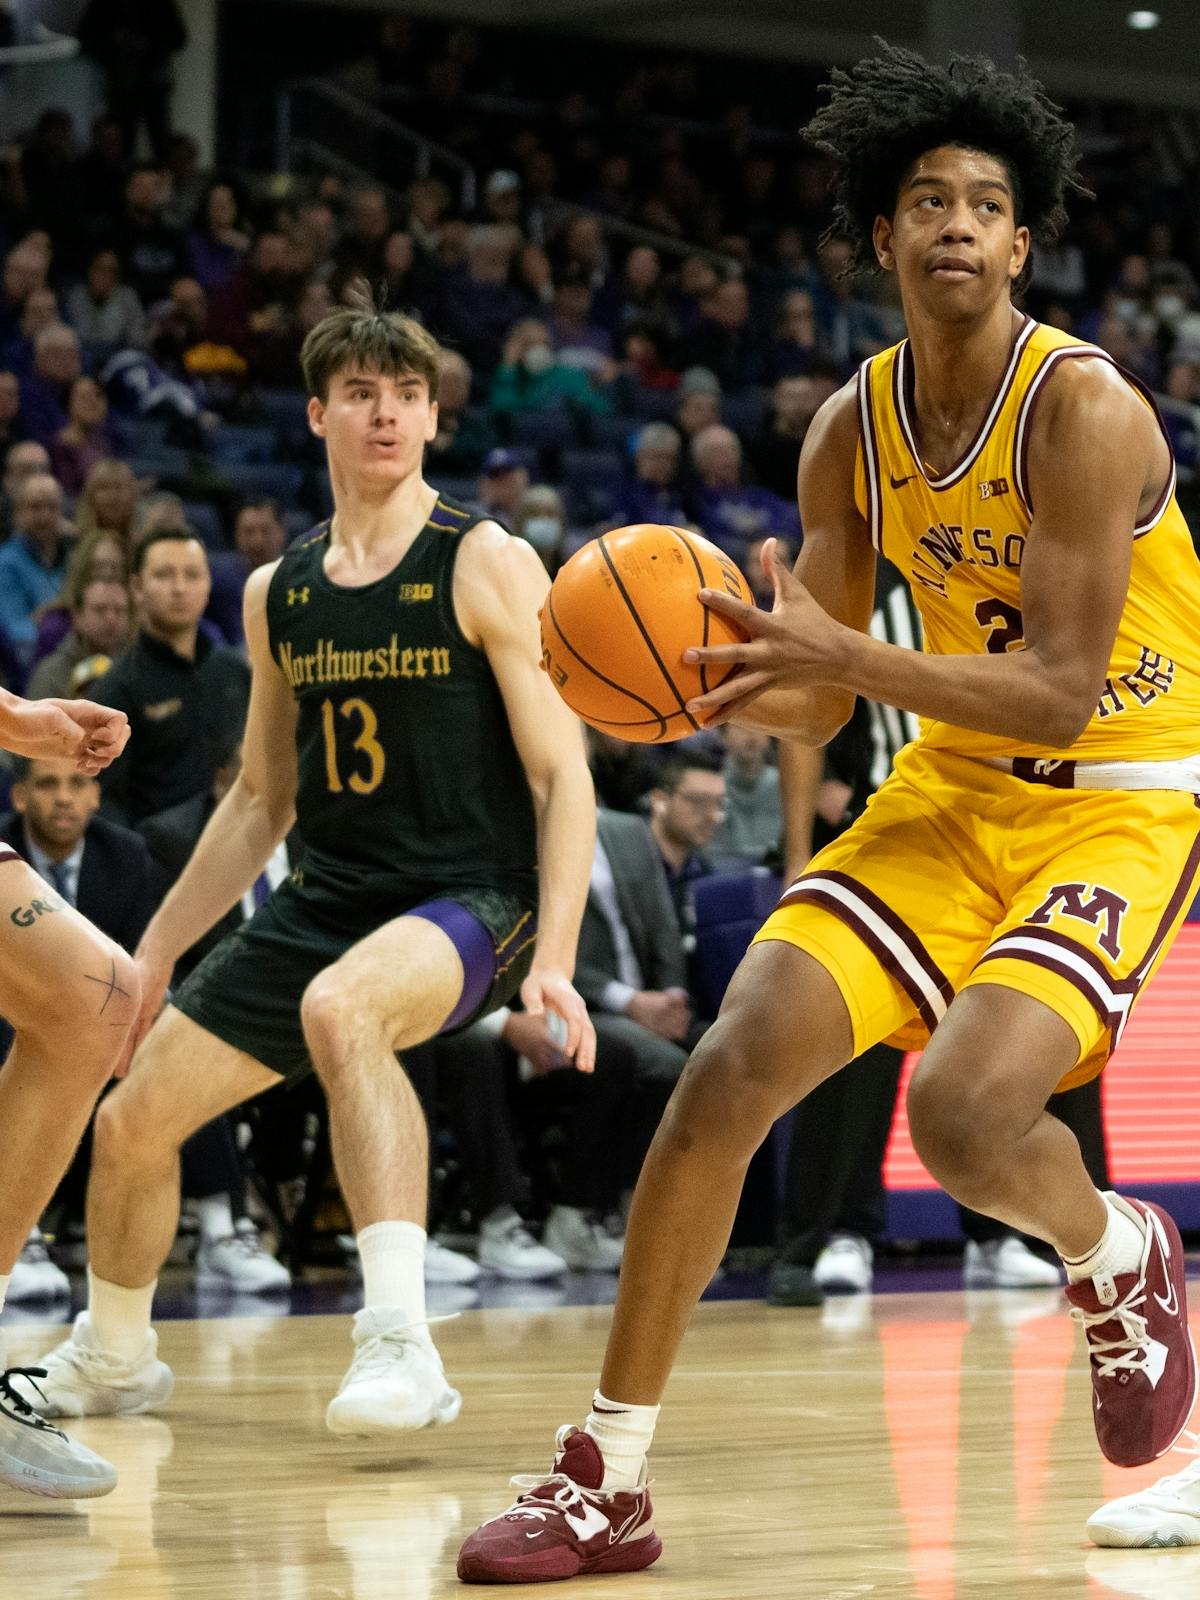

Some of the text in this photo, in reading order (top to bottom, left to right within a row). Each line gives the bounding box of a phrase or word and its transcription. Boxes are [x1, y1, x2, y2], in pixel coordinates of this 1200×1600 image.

[278, 633, 451, 687] Northwestern
[321, 697, 386, 795] 13
[1023, 882, 1131, 964] M
